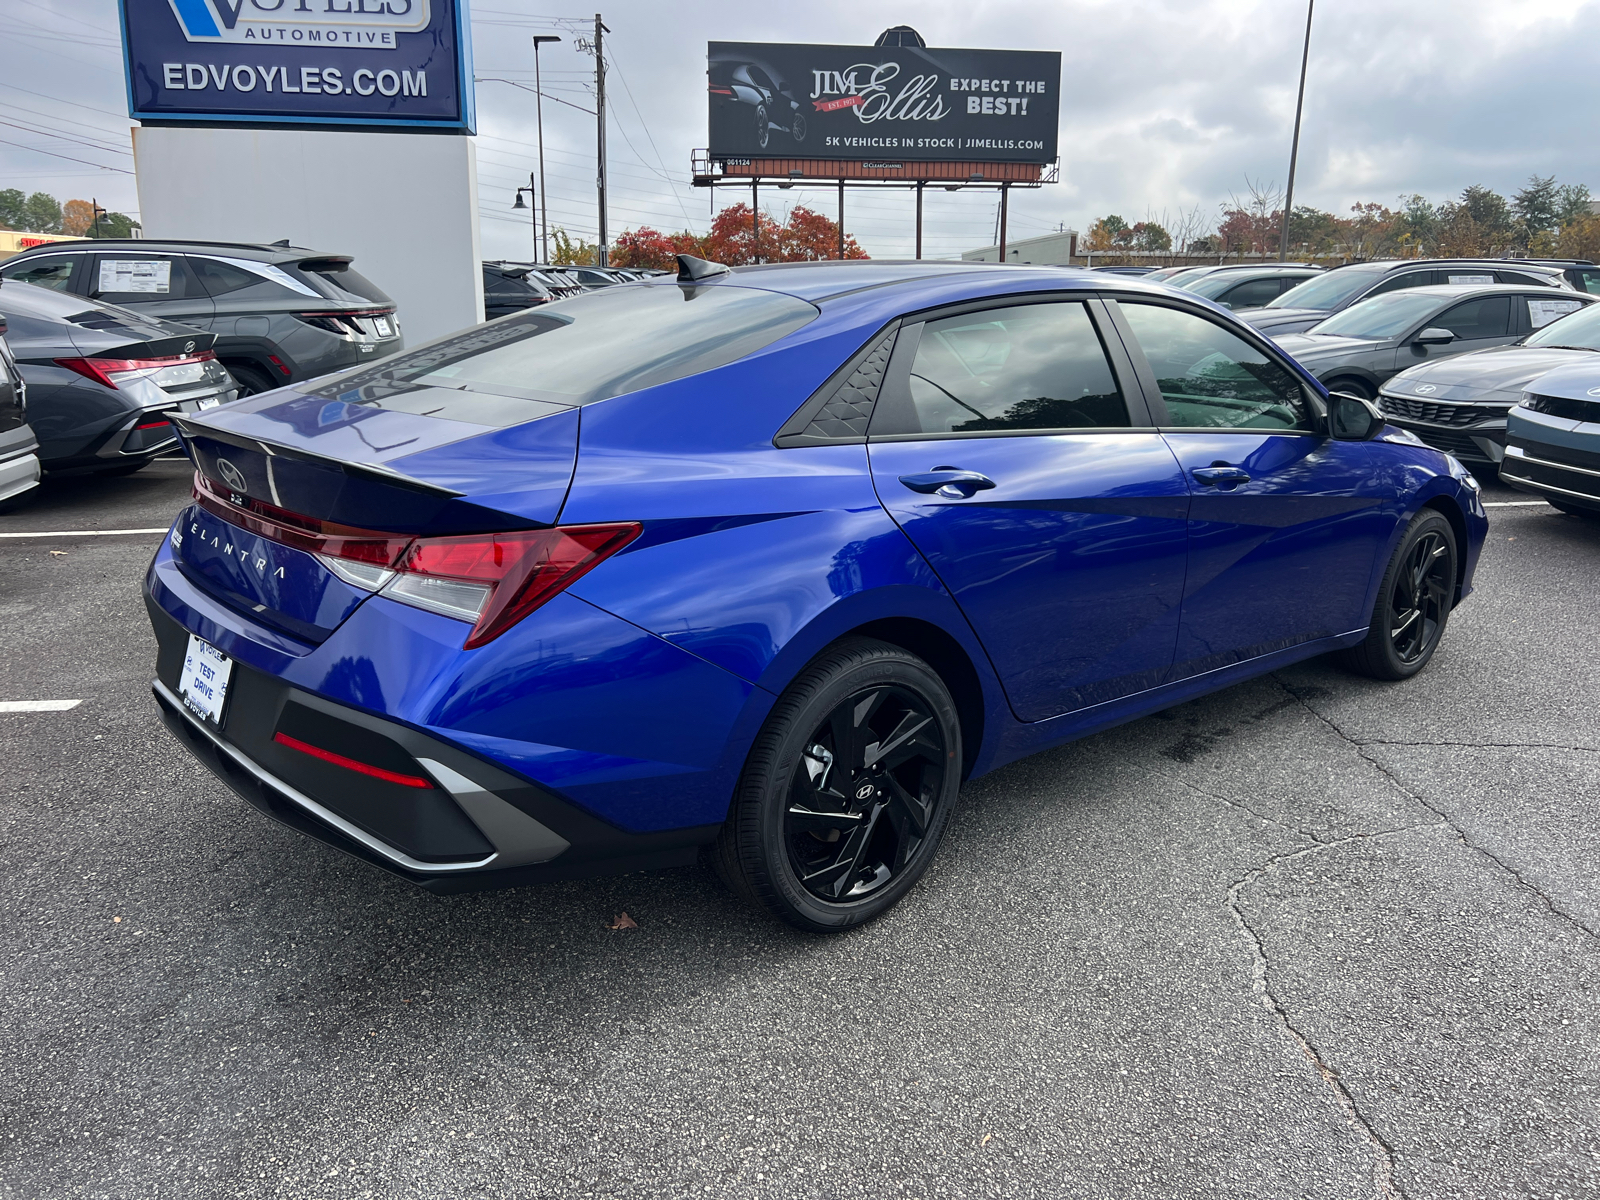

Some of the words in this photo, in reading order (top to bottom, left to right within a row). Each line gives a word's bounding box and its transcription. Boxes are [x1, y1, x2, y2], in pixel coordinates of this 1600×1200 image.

[245, 28, 391, 44] AUTOMOTIVE
[163, 63, 427, 97] EDVOYLES.COM
[950, 78, 1010, 92] EXPECT
[1016, 80, 1045, 93] THE
[810, 70, 858, 98] JIM
[843, 62, 951, 123] Ellis
[967, 96, 1028, 115] BEST!
[825, 136, 840, 146] 5K
[844, 137, 898, 147] VEHICLES
[902, 138, 914, 147] IN
[917, 138, 954, 148] STOCK
[966, 139, 1043, 149] JIMELLIS.COM
[191, 522, 285, 579] ELANTRA
[199, 661, 215, 681] TEST
[194, 677, 213, 700] DRIVE
